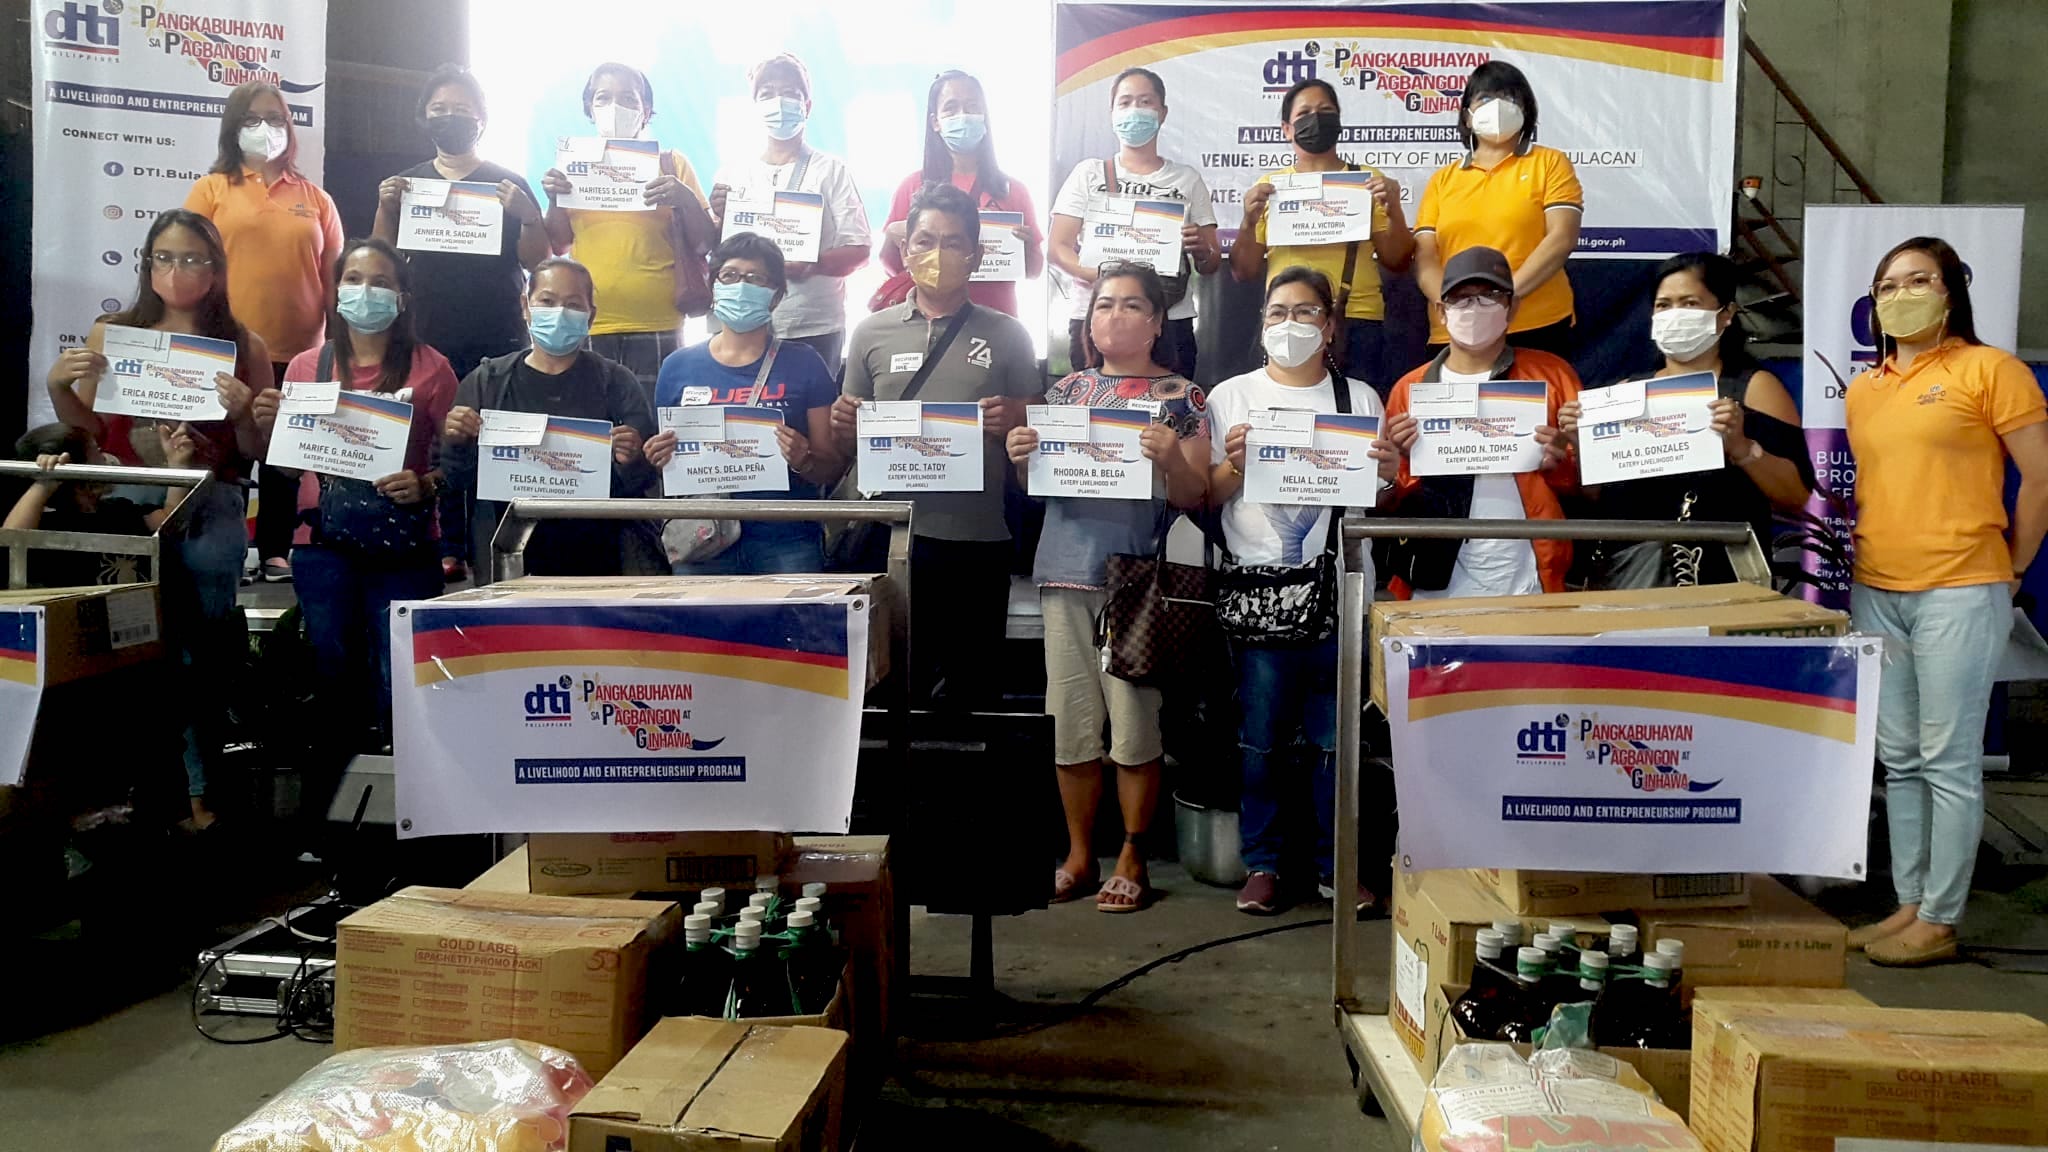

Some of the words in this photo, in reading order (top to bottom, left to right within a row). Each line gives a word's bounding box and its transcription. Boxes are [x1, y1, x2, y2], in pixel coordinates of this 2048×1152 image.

[45, 2, 120, 46] dti
[140, 4, 284, 41] PANGKABUHAYAN
[149, 38, 161, 49] SA
[164, 32, 267, 63] PAGBANGON
[270, 50, 281, 60] AT
[1263, 45, 1318, 84] dti
[1335, 48, 1490, 68] PANGKABUHAYAN
[1343, 77, 1355, 86] SA
[49, 88, 57, 98] A
[60, 89, 124, 105] LIVELIHOOD
[127, 95, 150, 108] AND
[152, 98, 226, 115] ENTREPRENEU
[1405, 92, 1460, 112] GINHA
[62, 127, 119, 142] CONNECT
[123, 133, 153, 145] WITH
[156, 136, 176, 147] US:
[1242, 128, 1250, 141] A
[1355, 128, 1460, 141] ENTREPRENEURSH
[1202, 153, 1254, 167] VENUE:
[1365, 152, 1402, 165] CITY
[1407, 152, 1430, 165] OF
[1569, 151, 1636, 165] ULACAN
[579, 186, 610, 195] MARITESS
[1211, 189, 1242, 203] ATE:
[414, 227, 444, 237] JENNIFER
[453, 230, 487, 239] SACDALAN
[1292, 222, 1309, 230] MYRA
[1318, 221, 1346, 229] VICTORIA
[59, 334, 76, 343] OR
[114, 359, 142, 375] dti
[122, 387, 146, 398] ERICA
[148, 390, 170, 401] ROSE
[181, 395, 206, 404] ABIOG
[131, 399, 152, 407] EATERY
[298, 441, 329, 454] MARIFE
[341, 448, 374, 462] RAÑOLA
[1438, 445, 1477, 455] ROLANDO
[1489, 443, 1518, 452] TOMAS
[1611, 449, 1632, 461] MILA
[1645, 441, 1690, 455] GONZALES
[303, 453, 324, 463] EATERY
[1446, 456, 1467, 464] EATERY
[1618, 460, 1640, 470] EATERY
[1640, 456, 1674, 467] LIVELIHOOD
[1675, 454, 1684, 462] KIT
[687, 466, 713, 475] NANCY
[724, 464, 744, 474] DELA
[745, 462, 766, 473] PEÑA
[888, 463, 907, 472] JOSE
[909, 463, 922, 472] DC.
[923, 463, 946, 472] TATOY
[1053, 467, 1089, 478] RHODORA
[1091, 469, 1099, 478] B.
[1100, 468, 1125, 478] BELGA
[509, 474, 538, 483] FELISA
[549, 477, 579, 488] CLAVEL
[698, 476, 718, 484] EATERY
[718, 475, 747, 483] LIVELIHOOD
[1282, 475, 1306, 484] NELIA
[1317, 476, 1339, 485] CRUZ
[513, 485, 533, 493] EATERY
[534, 486, 565, 495] LIVELIHOOD
[525, 680, 571, 714] dti
[583, 679, 693, 703] PANGKABUHAYAN
[591, 711, 600, 721] SA
[602, 704, 681, 726] PAGBANGON
[683, 710, 691, 719] AT
[636, 727, 692, 749] GINHAWA
[1517, 720, 1567, 752] dti
[1580, 719, 1693, 742] PANGKABUHAYAN
[1586, 750, 1596, 760] SA
[1598, 743, 1679, 766] PAGBANGON
[1682, 750, 1690, 760] AT
[518, 766, 525, 779] A
[527, 766, 580, 779] LIVELIHOOD
[583, 766, 601, 778] AND
[604, 764, 695, 777] ENTREPRENEURSHIP
[697, 764, 741, 777] PROGRAM
[1632, 768, 1688, 789] GINHAWA
[1505, 803, 1513, 816] A
[1515, 804, 1571, 817] LIVELIHOOD
[1573, 805, 1593, 818] AND
[1596, 806, 1690, 819] ENTREPRENEURSHIP
[1692, 806, 1737, 819] PROGRAM
[439, 938, 475, 952] GOLD
[479, 941, 519, 955] LABEL
[417, 951, 472, 965] SPAGHETTI
[473, 956, 510, 968] PROMO
[512, 958, 540, 970] PACK
[1896, 1069, 1945, 1084] GOLD
